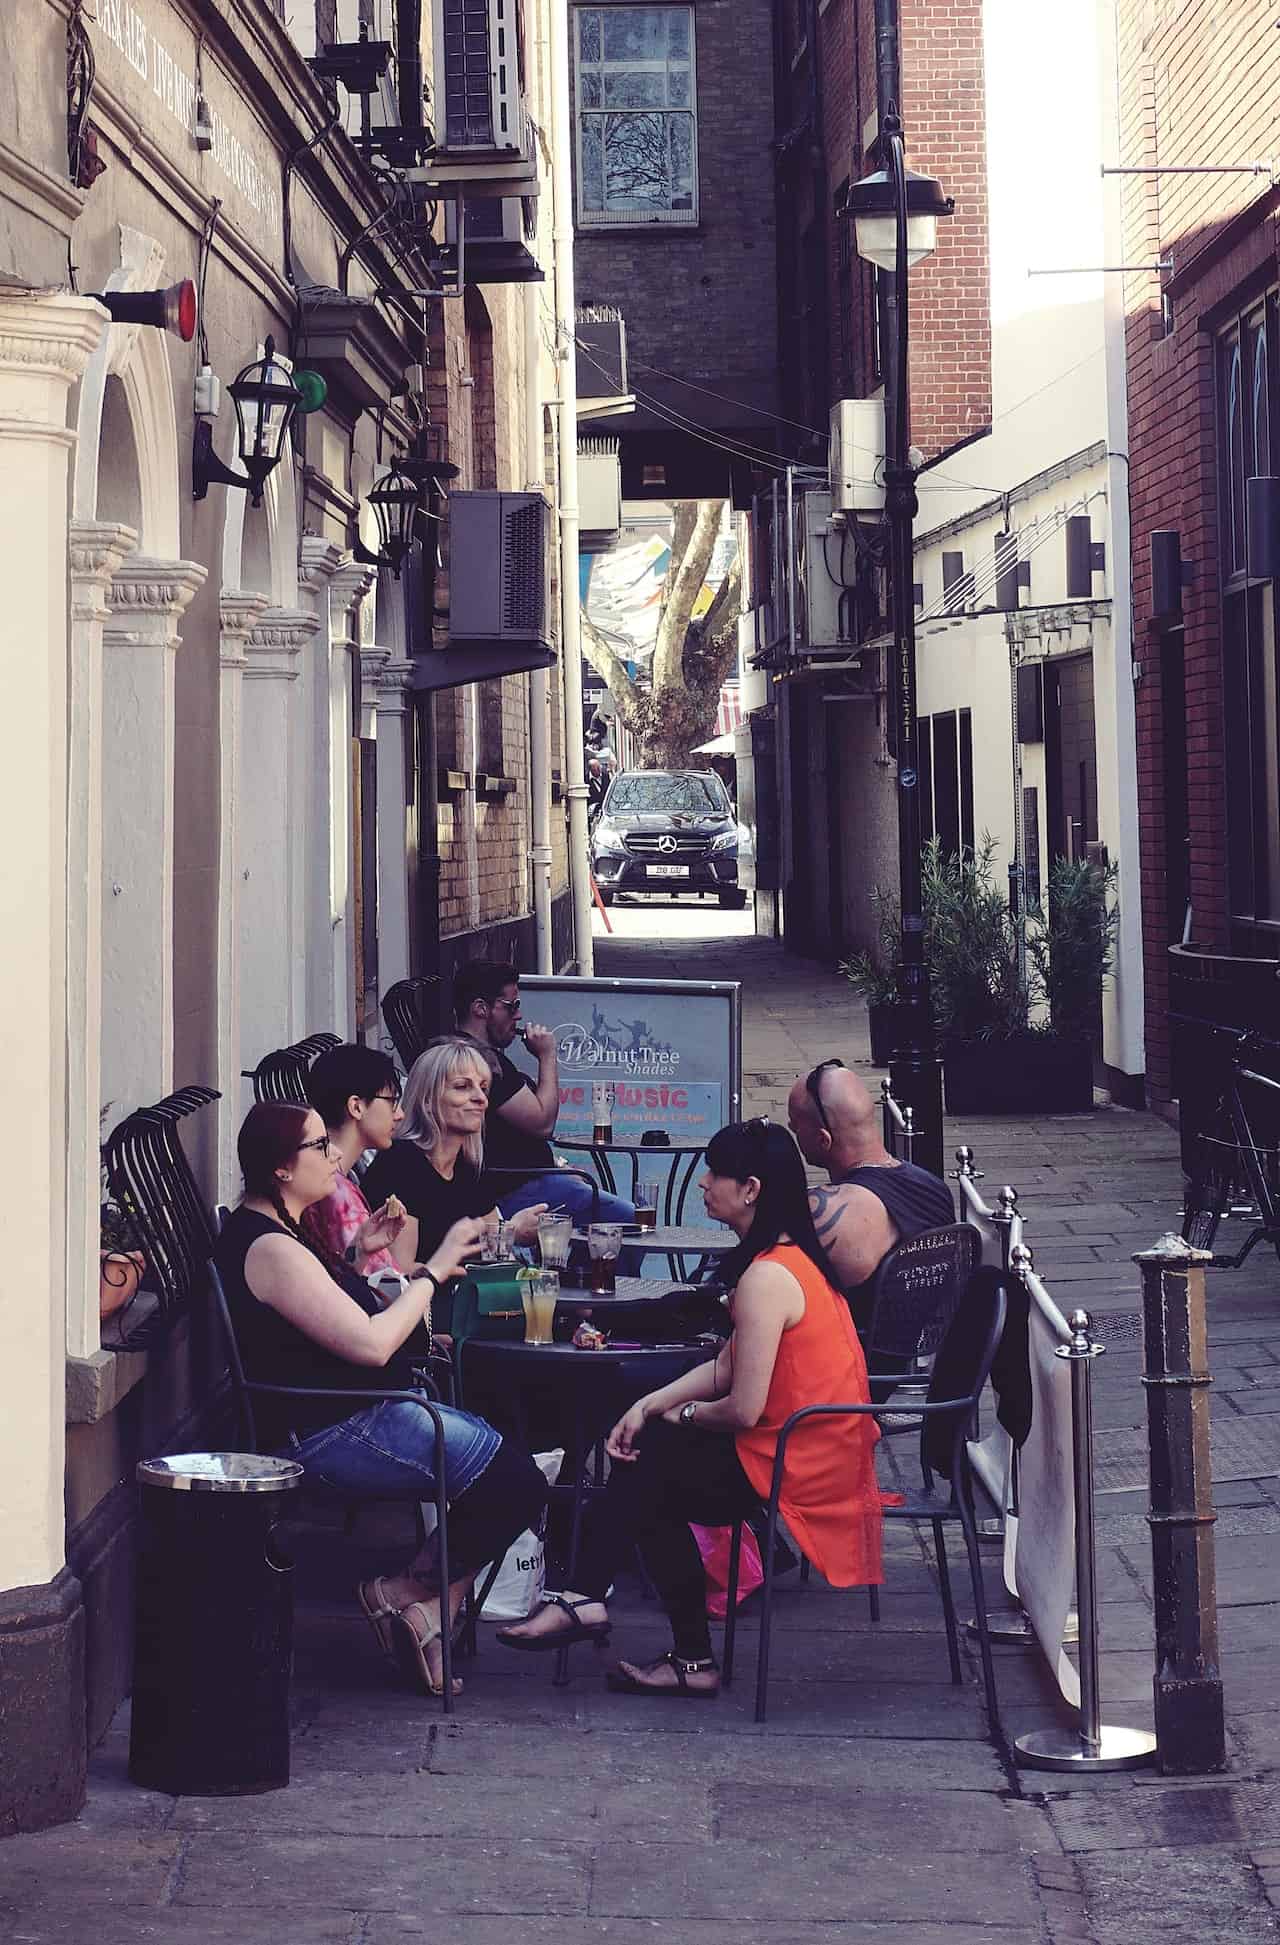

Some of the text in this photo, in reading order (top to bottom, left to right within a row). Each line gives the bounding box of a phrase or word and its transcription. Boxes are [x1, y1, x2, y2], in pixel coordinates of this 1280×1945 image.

[124, 2, 148, 81] ALES
[152, 37, 174, 113] LIVE
[560, 1037, 681, 1064] Walnut Tree
[624, 1062, 676, 1076] Shades
